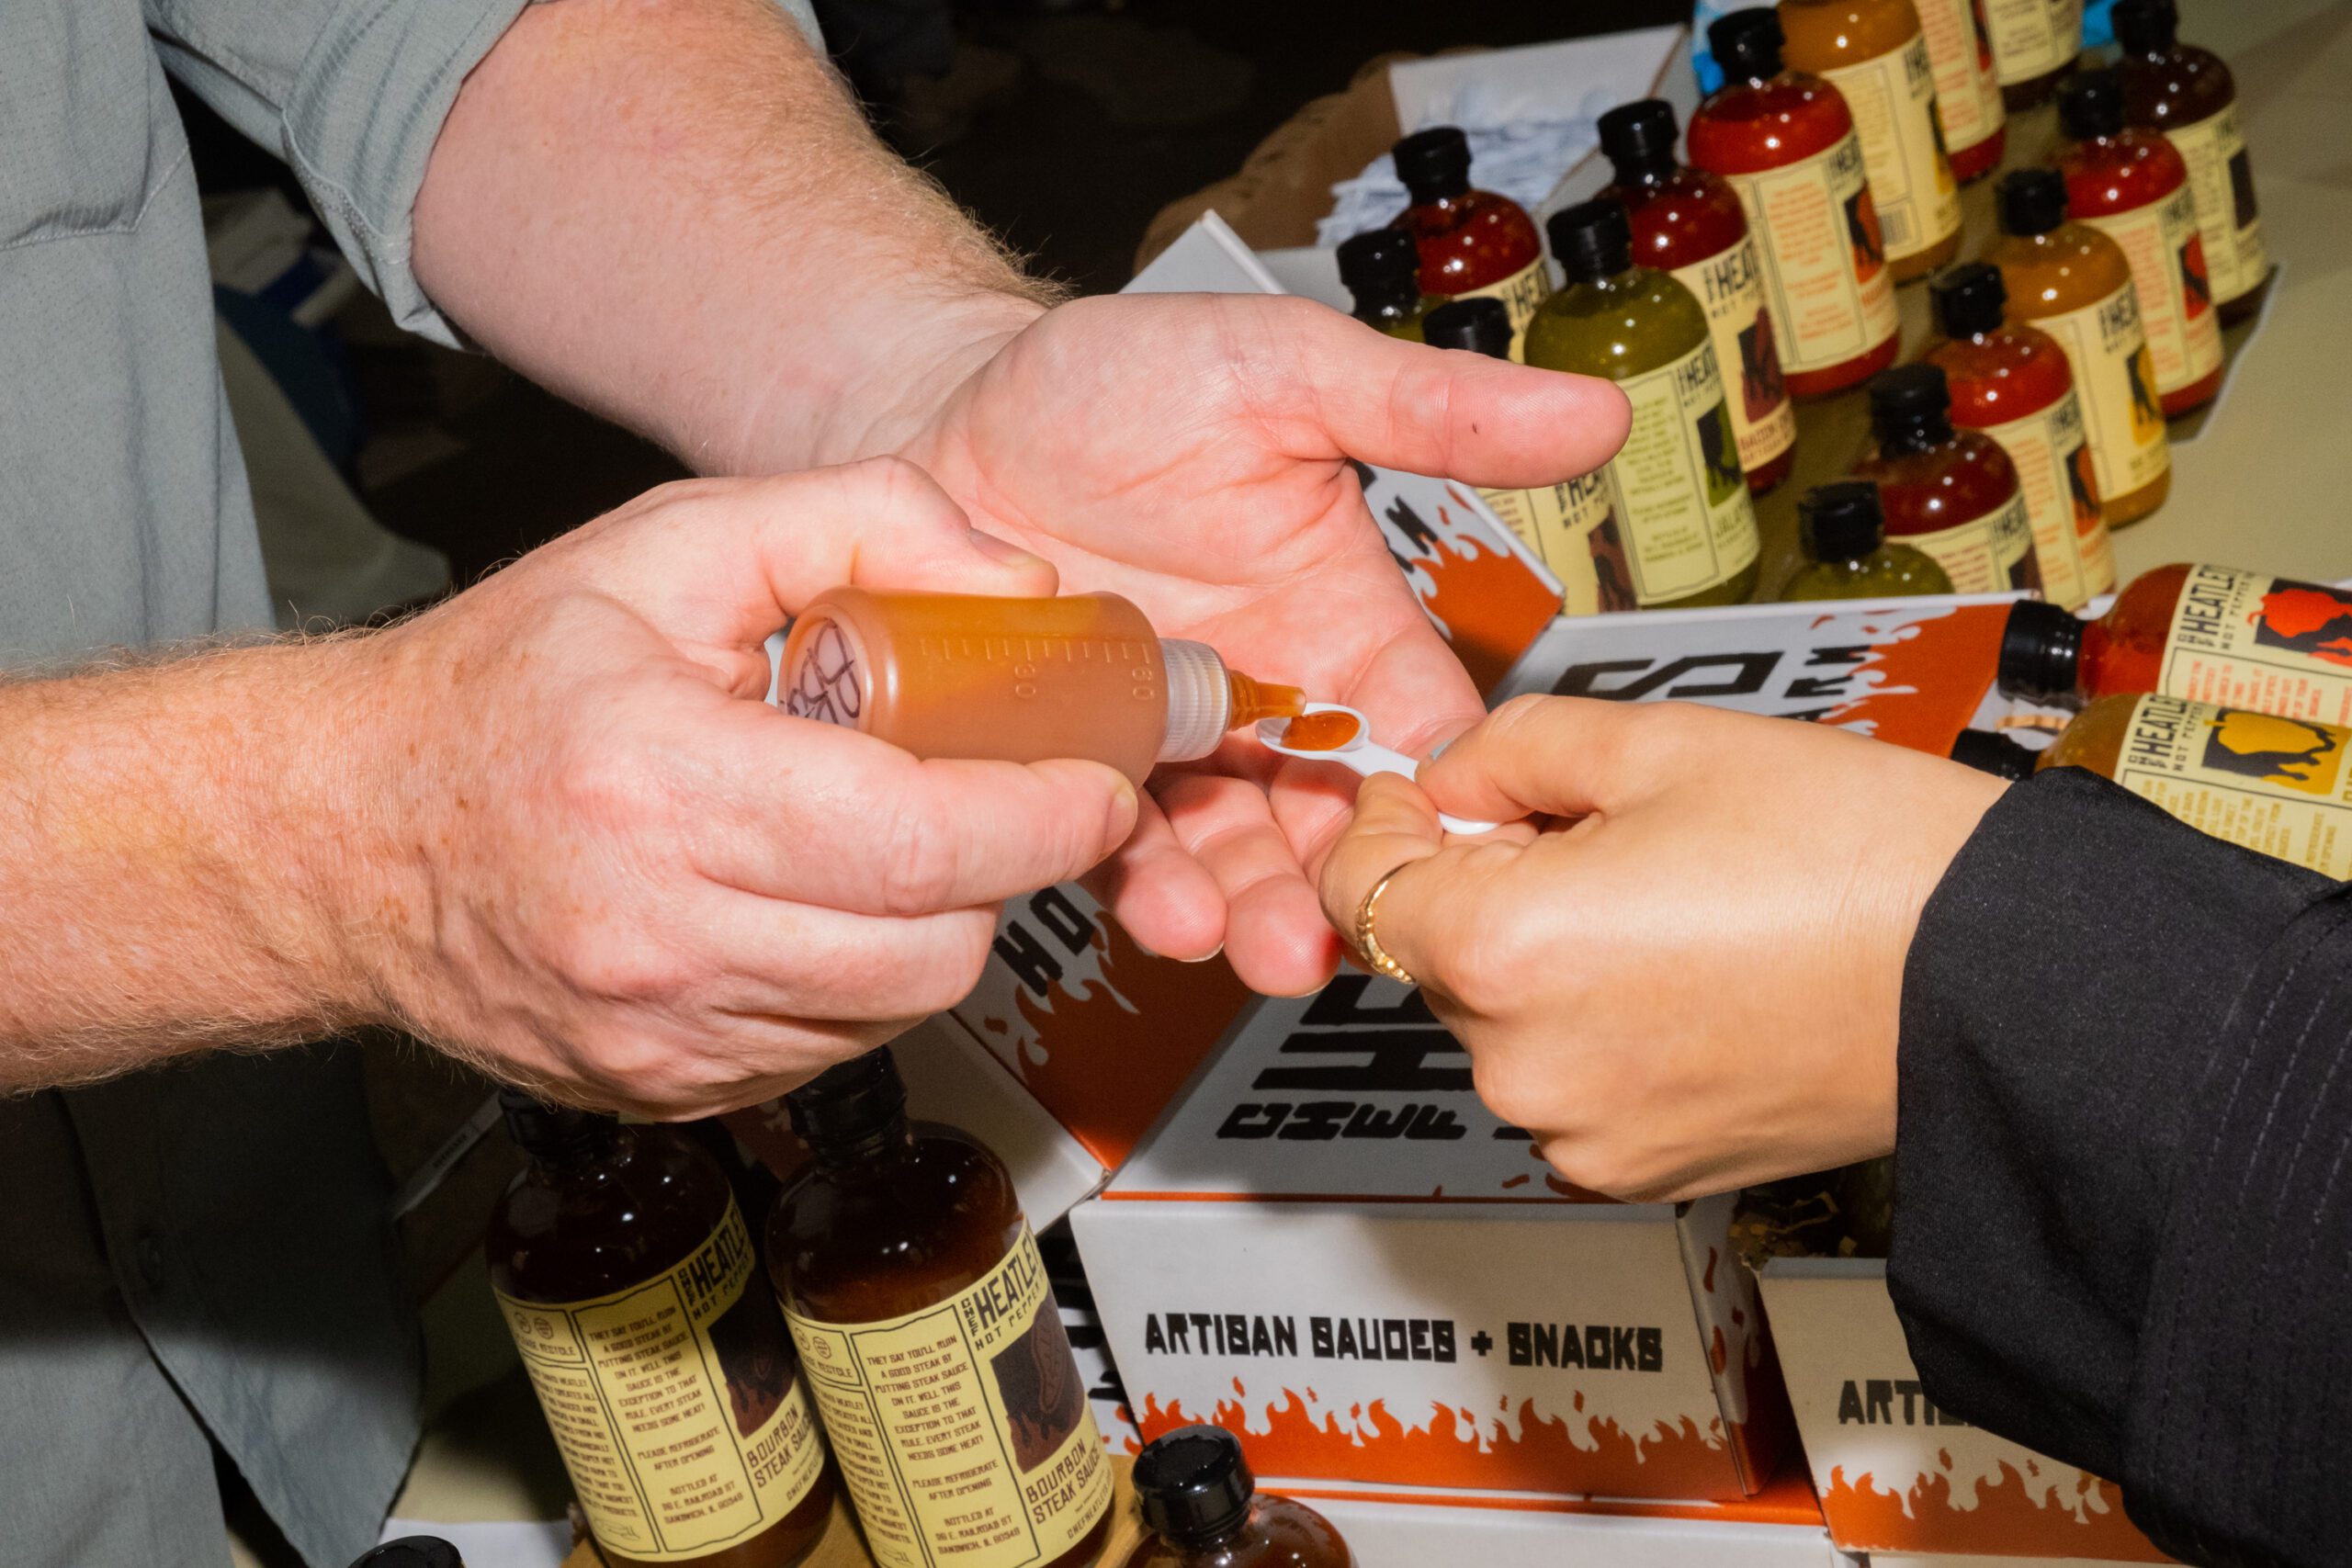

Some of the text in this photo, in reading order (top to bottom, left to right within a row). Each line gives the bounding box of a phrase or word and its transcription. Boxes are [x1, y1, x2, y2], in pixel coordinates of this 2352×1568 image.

[975, 1325, 1001, 1351] HOT
[1146, 1314, 1297, 1357] ARTISAN
[1310, 1317, 1456, 1362] SAUCES
[1508, 1322, 1663, 1372] SNACKS
[889, 1353, 905, 1363] SAY
[913, 1360, 941, 1372] STEAK
[875, 1362, 968, 1393] PUTTING STEAK SAUCE
[891, 1397, 904, 1406] ON
[941, 1382, 962, 1394] THIS
[902, 1397, 960, 1419] SAUCE IS THE
[1838, 1380, 1968, 1426] ARTI
[895, 1406, 977, 1434] EXCEPTION TO THAT
[954, 1420, 981, 1437] STEAK
[746, 1404, 799, 1468] BOURBON
[754, 1444, 792, 1488] STEAK
[1025, 1438, 1086, 1505] BOURBON
[984, 1506, 994, 1516] AT
[1033, 1480, 1077, 1525] STEAK
